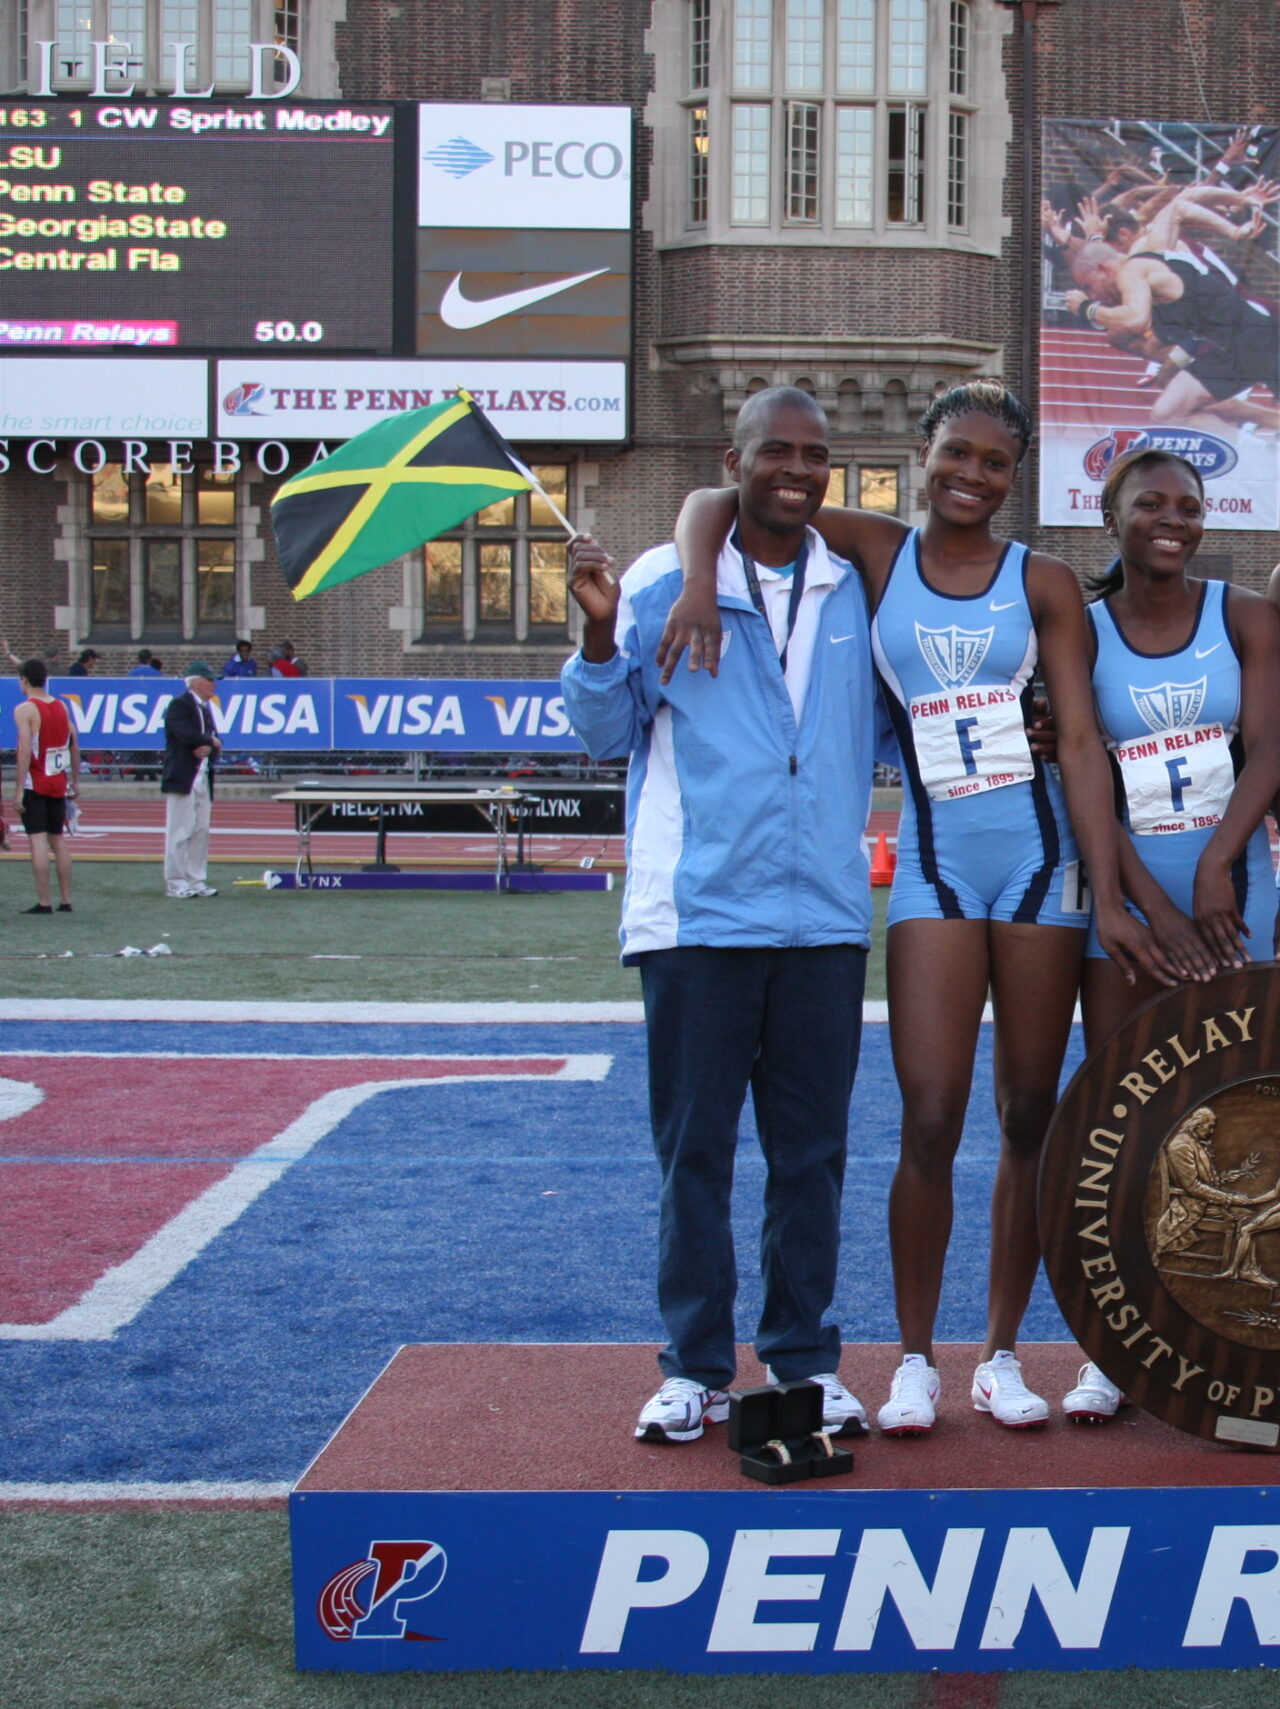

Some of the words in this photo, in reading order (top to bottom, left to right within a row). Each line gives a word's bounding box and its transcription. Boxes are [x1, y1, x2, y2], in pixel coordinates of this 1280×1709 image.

[97, 106, 158, 129] CW
[169, 107, 266, 135] Sprint
[275, 109, 390, 136] Medley
[0, 145, 62, 170] SU
[503, 141, 623, 180] PECO
[0, 179, 76, 202] Penn
[88, 180, 187, 204] State
[0, 212, 227, 243] GeorgiaState
[0, 247, 118, 271] Central
[128, 248, 181, 272] Fla
[70, 322, 173, 346] Relays
[255, 321, 323, 342] 50.0
[271, 388, 337, 410] THE
[344, 389, 433, 411] PENN
[0, 413, 33, 431] he
[40, 415, 112, 431] smart
[120, 414, 203, 432] choice
[1151, 437, 1203, 451] PENN
[208, 694, 320, 735] VISA
[344, 694, 466, 735] VISA
[484, 696, 576, 737] VIS
[911, 699, 950, 719] PENN
[956, 691, 1017, 710] RELAYS
[955, 716, 983, 776] F
[1117, 741, 1159, 762] PENN
[1164, 727, 1223, 751] RELAYS
[948, 782, 981, 798] since
[1164, 756, 1193, 813] F
[1152, 821, 1185, 833] since
[1191, 814, 1221, 829] 1895
[1120, 1006, 1256, 1106] RELAY
[1075, 1127, 1206, 1391] UNIVERSITY
[1207, 1380, 1242, 1407] OF
[579, 1526, 1131, 1655] PENN
